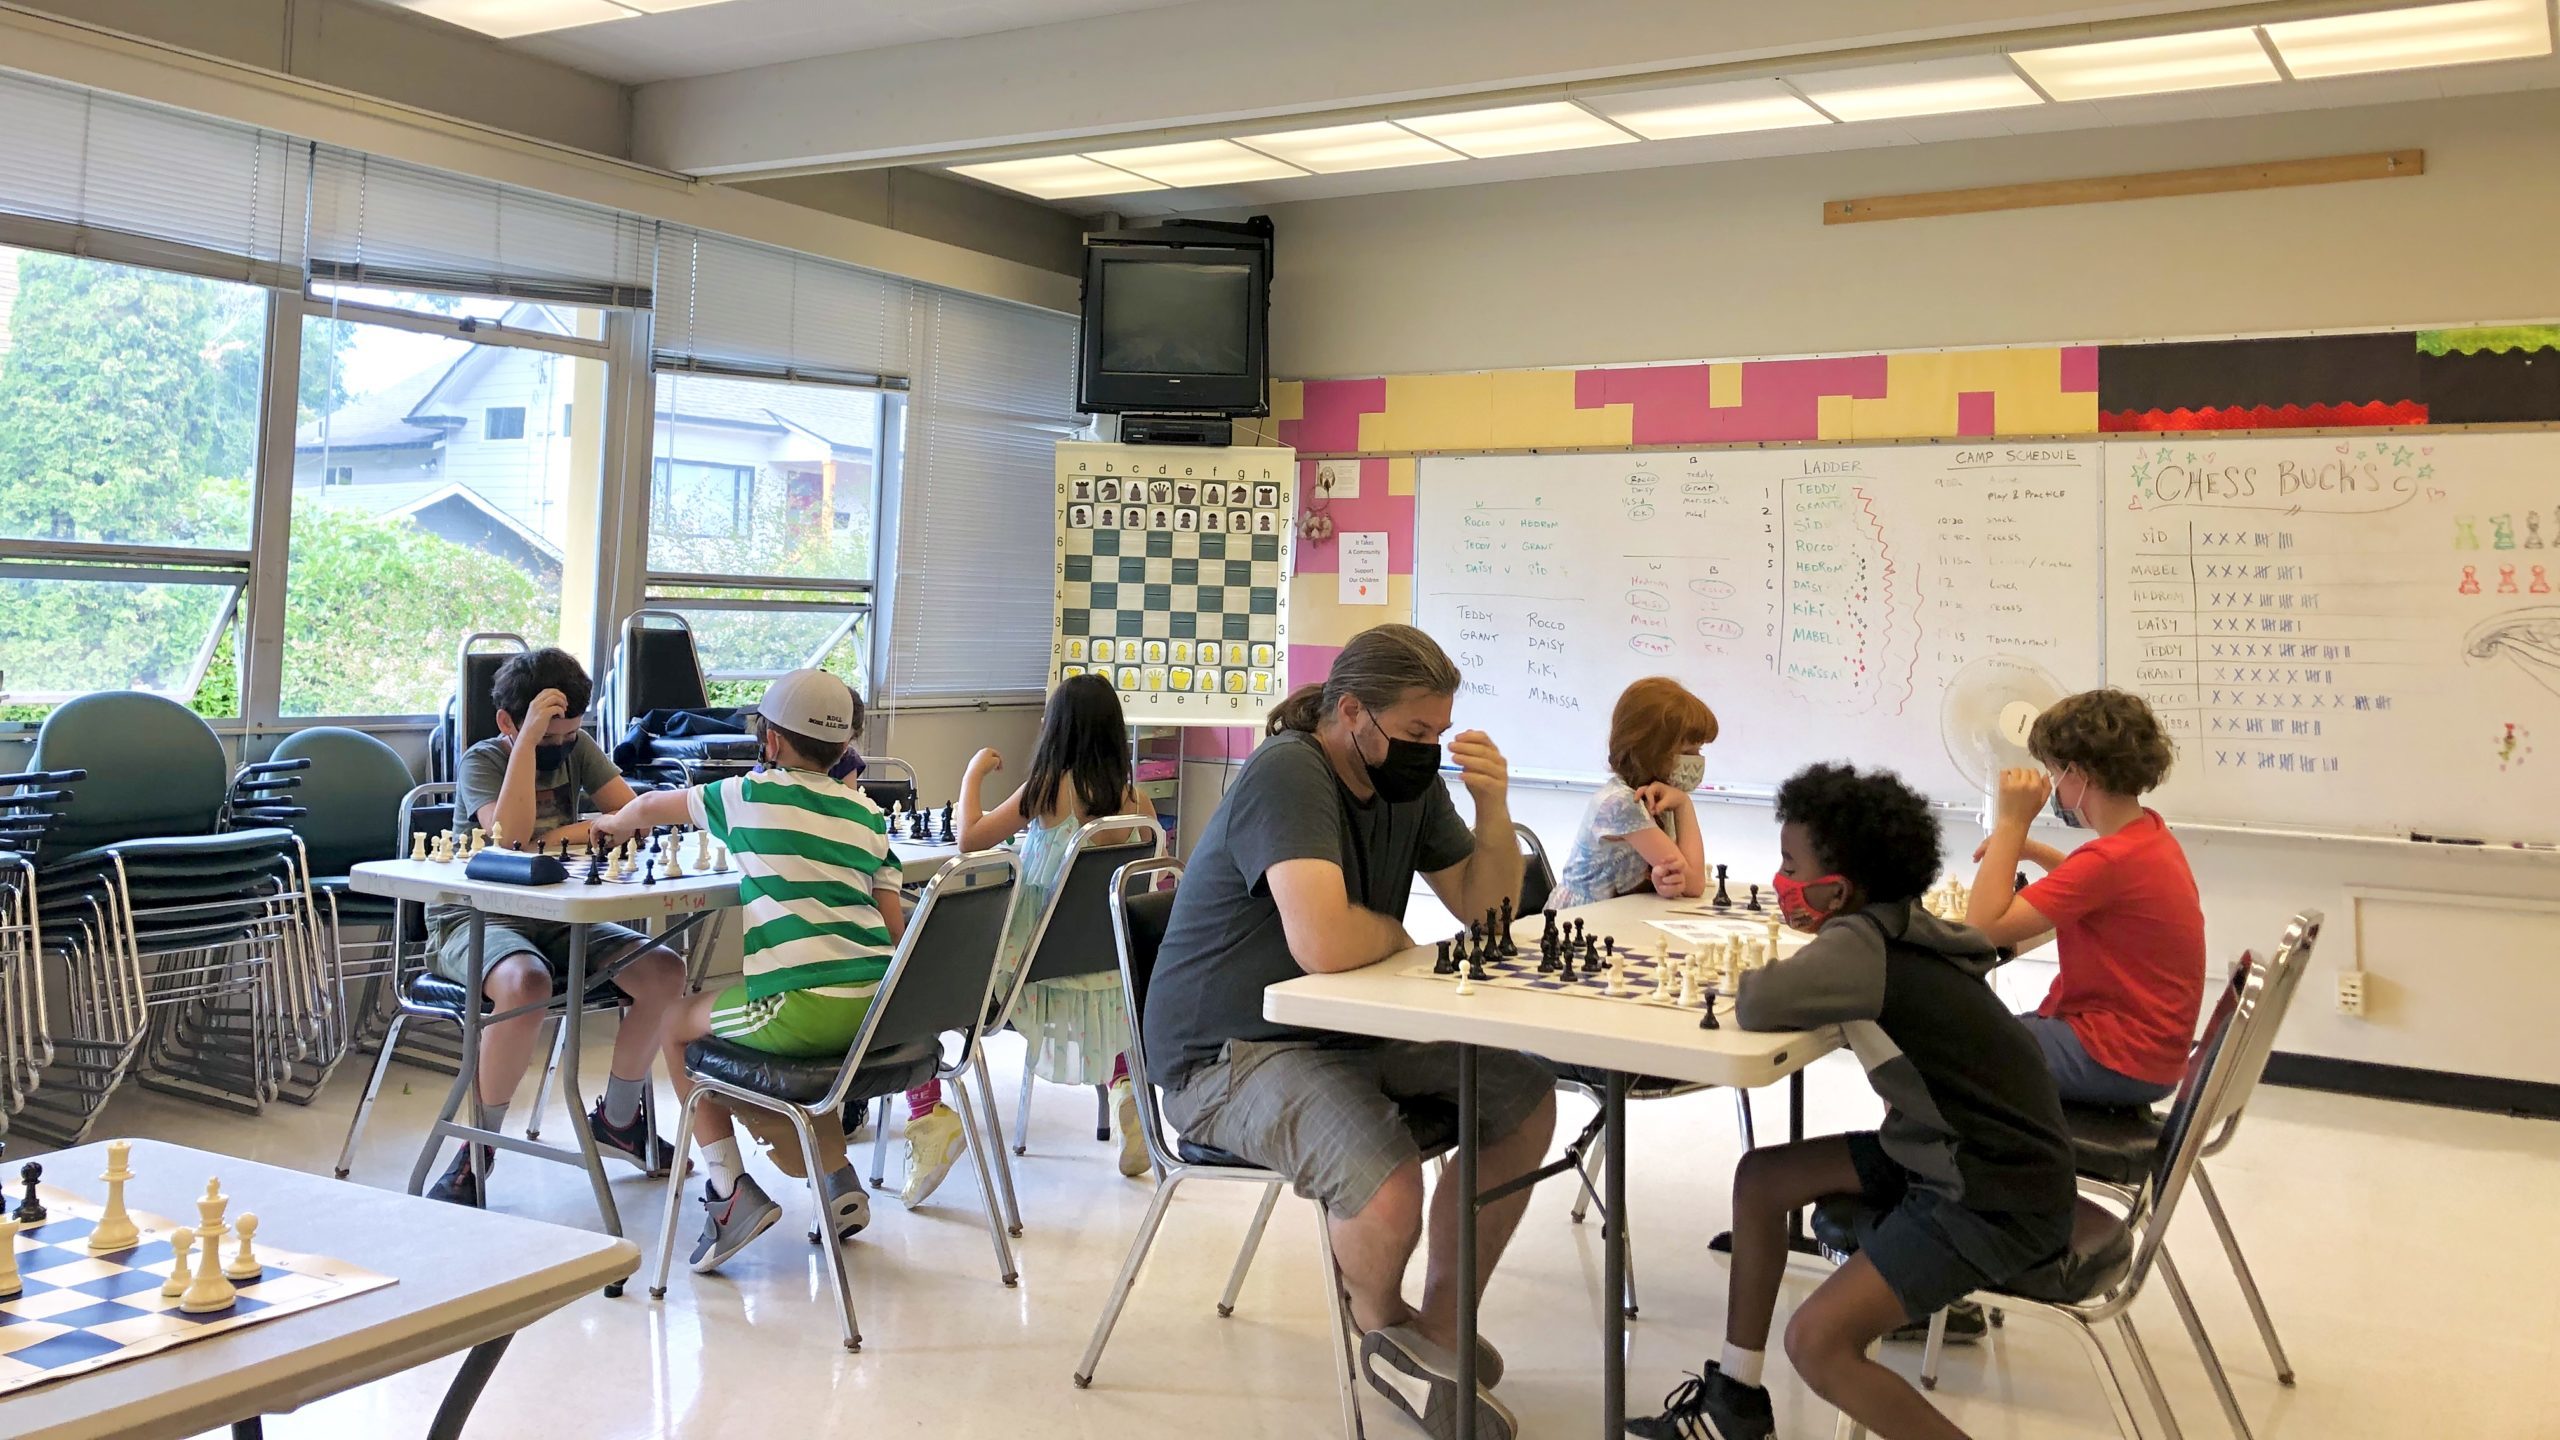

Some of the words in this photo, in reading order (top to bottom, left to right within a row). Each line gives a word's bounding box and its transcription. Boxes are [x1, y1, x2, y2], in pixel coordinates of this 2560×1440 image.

[1956, 451, 1994, 464] CAMP
[1079, 462, 1086, 471] a
[1106, 462, 1113, 472] b
[1132, 465, 1139, 473] c
[1159, 464, 1166, 474] d
[1186, 468, 1192, 476] e
[1212, 466, 1216, 476] f
[1238, 470, 1245, 480] g
[1264, 469, 1270, 478] h
[1804, 459, 1862, 475] LADDER
[1058, 484, 1064, 494] 8
[2156, 466, 2256, 502] CHESS
[1283, 493, 1290, 502] 8
[1058, 510, 1064, 520] 7
[1762, 507, 1772, 516] 2
[1282, 519, 1288, 528] 7
[1057, 537, 1063, 547] 6
[1281, 546, 1288, 556] 6
[1056, 564, 1062, 574] 5
[1280, 572, 1286, 582] 5
[1056, 590, 1062, 600] 4
[1279, 598, 1286, 608] 4
[1457, 605, 1493, 622] TEDDY
[1056, 617, 1060, 628] 3
[1527, 612, 1566, 630] ROCCO
[1278, 624, 1285, 634] 3
[1767, 623, 1774, 637] 8
[1460, 629, 1500, 642] GRANT
[1054, 644, 1060, 654] 2
[2144, 644, 2184, 658] TEDDY
[1278, 652, 1284, 661] 2
[1054, 671, 1057, 681] 1
[2136, 667, 2184, 680] GRANT
[1278, 678, 1282, 688] 1
[1462, 680, 1498, 696] MABEL
[1124, 695, 1130, 703] c
[1150, 693, 1158, 704] d
[1178, 696, 1184, 704] e
[1205, 695, 1210, 704] f
[1230, 697, 1238, 708] g
[1256, 697, 1263, 706] h
